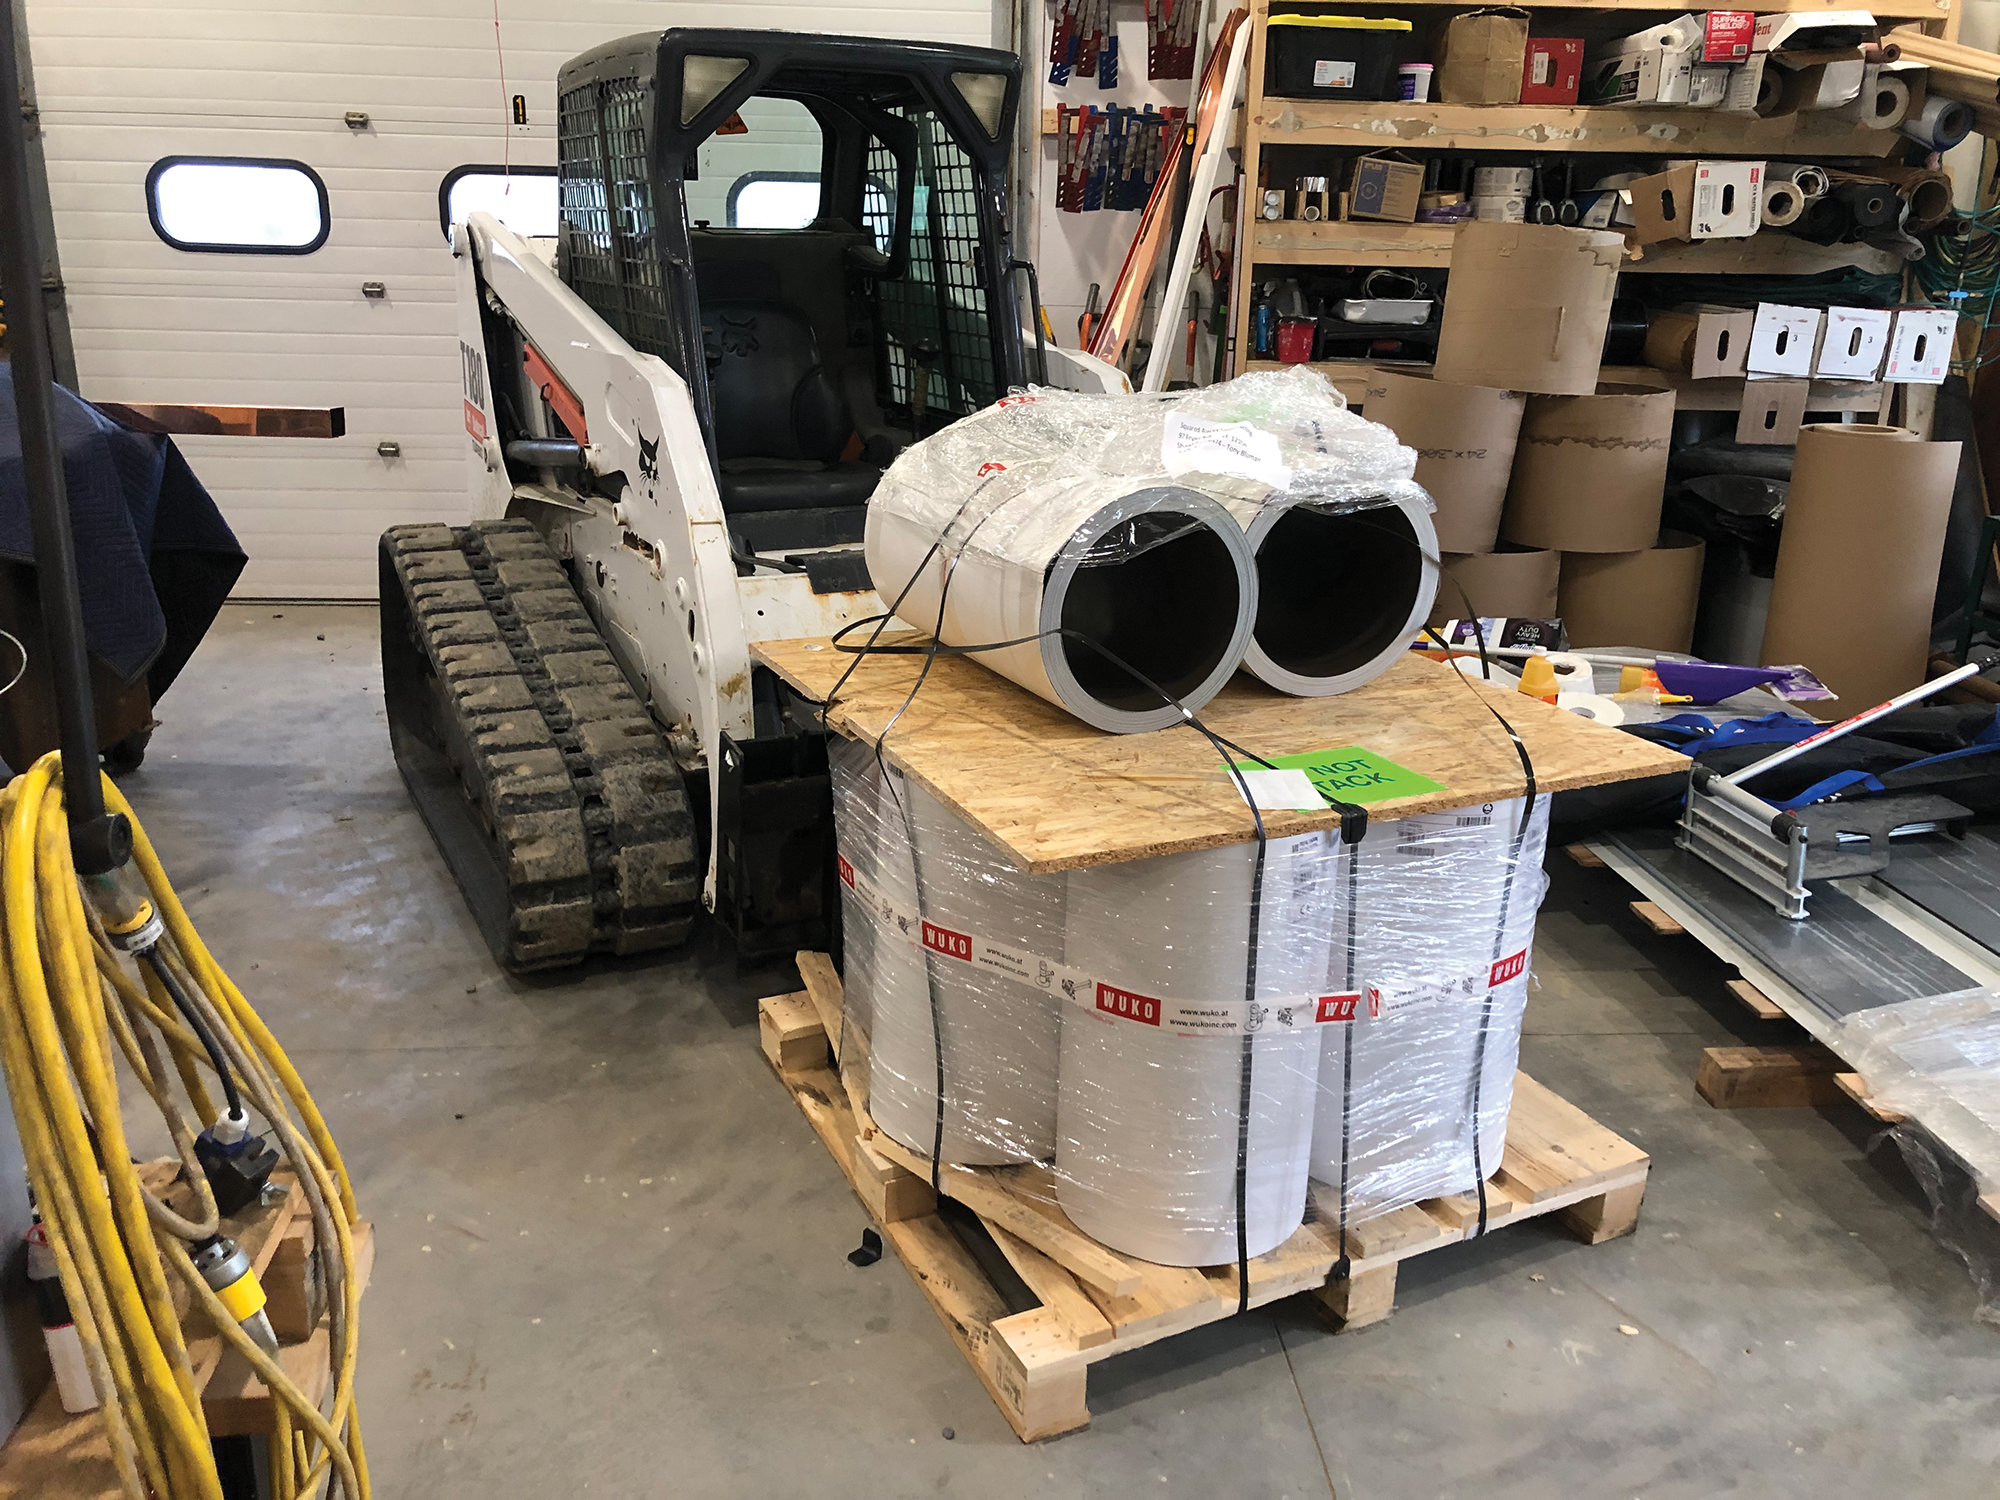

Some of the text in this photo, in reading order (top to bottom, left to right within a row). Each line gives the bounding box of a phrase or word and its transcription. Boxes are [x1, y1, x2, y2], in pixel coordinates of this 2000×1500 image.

[1712, 15, 1746, 23] SURFACE
[1711, 22, 1744, 30] SHIELDS
[1793, 334, 1798, 342] 3
[1868, 336, 1873, 344] 3
[460, 340, 485, 410] T180
[1515, 631, 1541, 639] HEAVY
[1518, 626, 1540, 634] DUTY
[1308, 759, 1373, 776] NOT
[1312, 772, 1396, 792] TACK
[926, 927, 967, 955] WUKO
[986, 947, 1023, 965] www.wuko.at
[1494, 955, 1524, 982] WUKO
[1103, 990, 1154, 1019] WUKO
[1179, 1008, 1229, 1017] www.wuko.at
[1169, 1019, 1237, 1029] www.wukoinc.com
